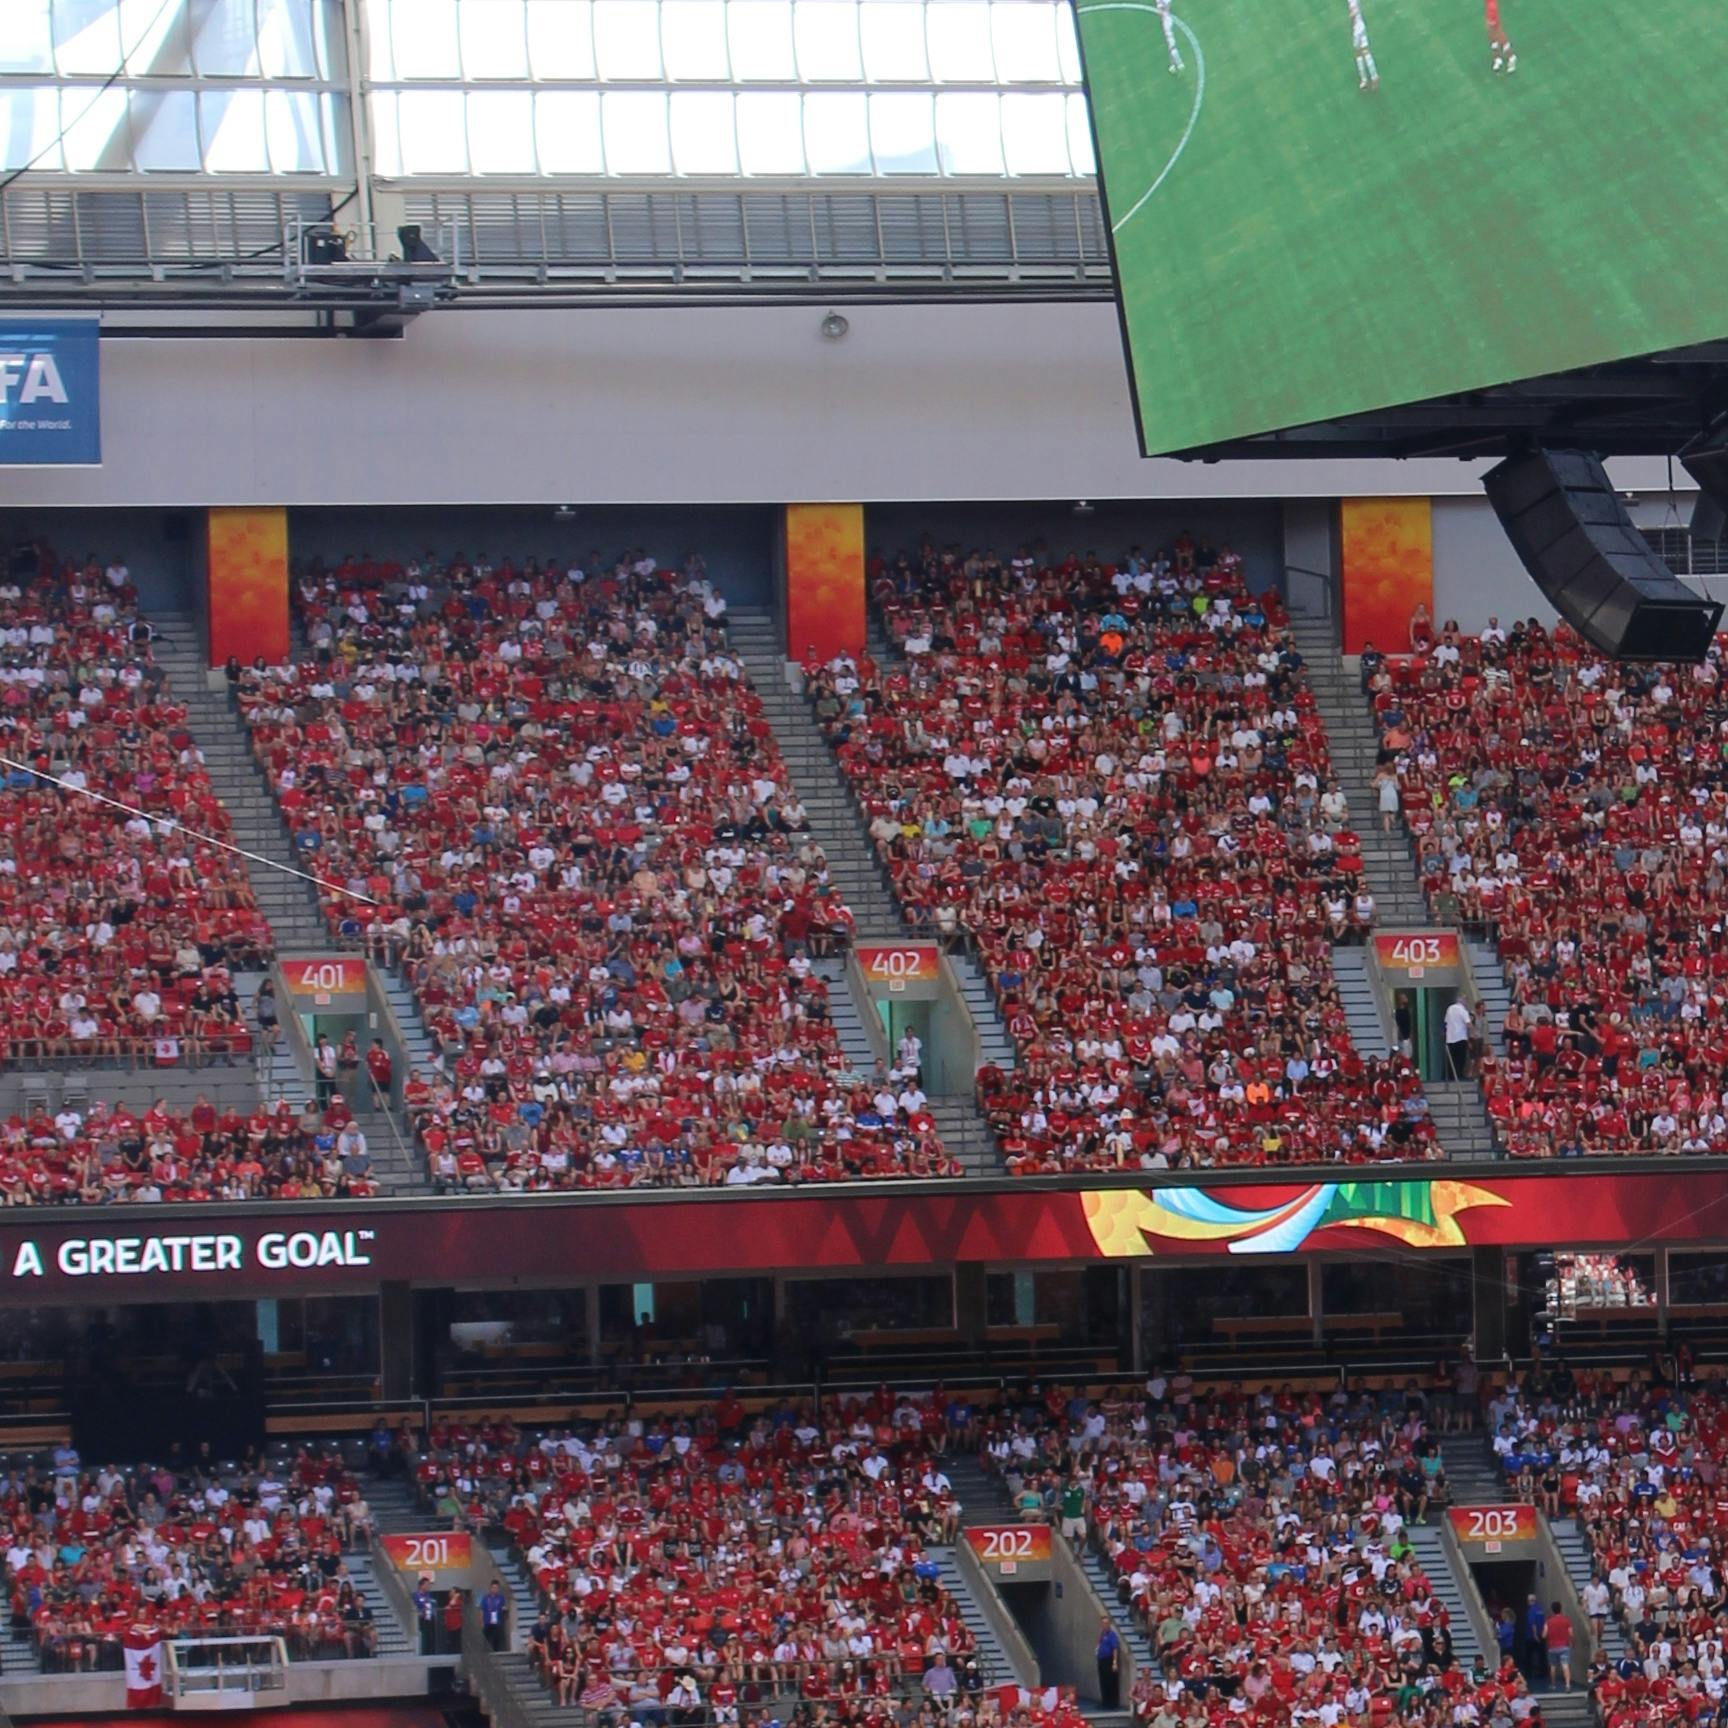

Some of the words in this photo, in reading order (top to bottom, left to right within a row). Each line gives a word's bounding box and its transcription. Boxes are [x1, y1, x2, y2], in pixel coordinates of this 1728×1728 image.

[17, 419, 36, 430] the
[37, 418, 72, 430] World.
[871, 951, 921, 976] 402
[1391, 939, 1441, 963] 403
[301, 964, 344, 989] 401
[12, 1241, 43, 1276] A
[57, 1235, 242, 1275] GREATER
[1468, 1510, 1518, 1536] 203
[405, 1538, 447, 1565] 201
[982, 1530, 1032, 1557] 202
